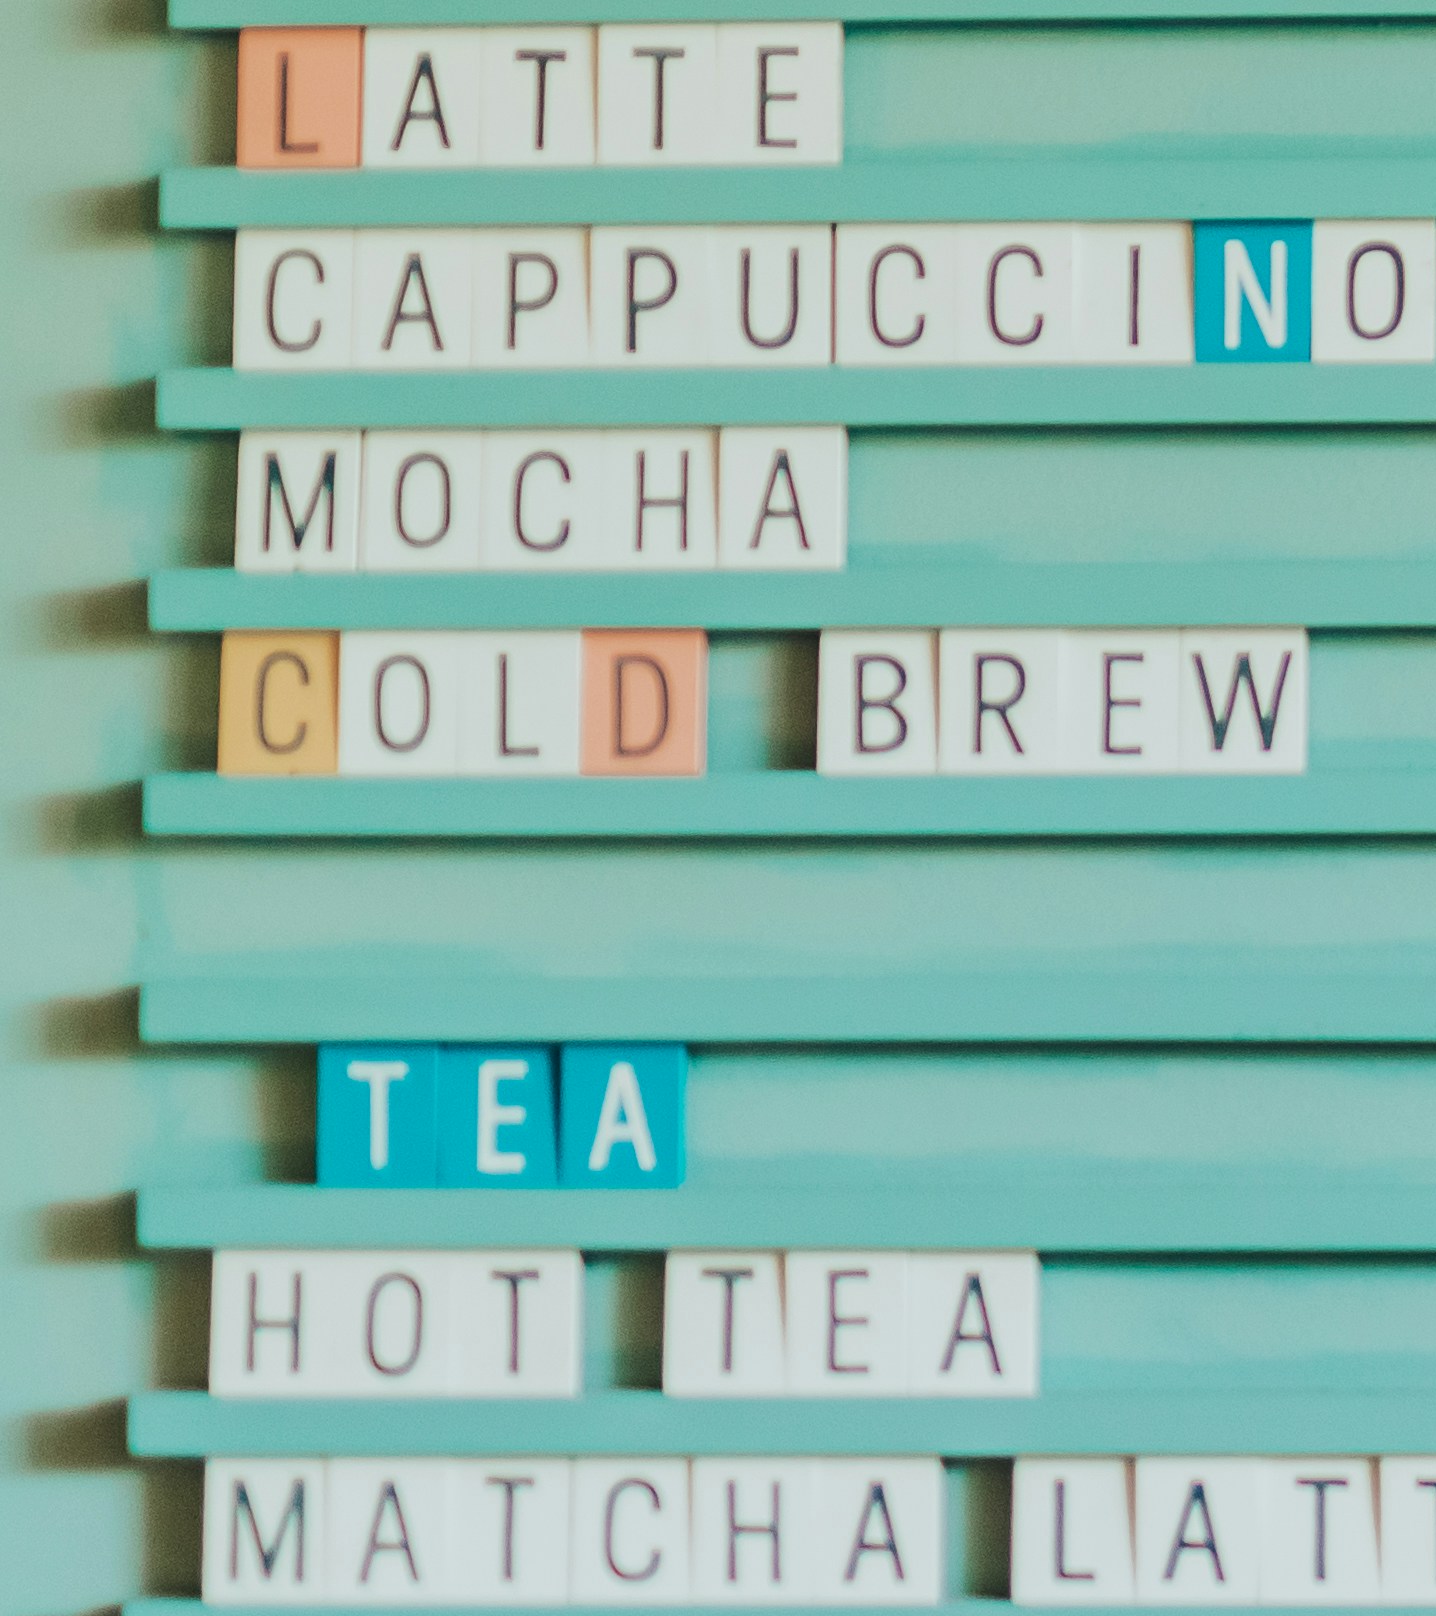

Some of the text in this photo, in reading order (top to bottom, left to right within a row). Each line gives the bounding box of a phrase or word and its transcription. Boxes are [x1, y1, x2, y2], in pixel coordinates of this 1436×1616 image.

[275, 47, 802, 154] LATTE
[264, 239, 1403, 354] CAPPUCCINO
[259, 449, 811, 554] MOCHA
[252, 650, 673, 760] COLD
[851, 647, 1294, 756] BREW
[345, 1060, 659, 1176] TEA
[244, 1271, 542, 1377] HOT
[700, 1267, 1004, 1379] TEA
[230, 1477, 907, 1585] MATCHA
